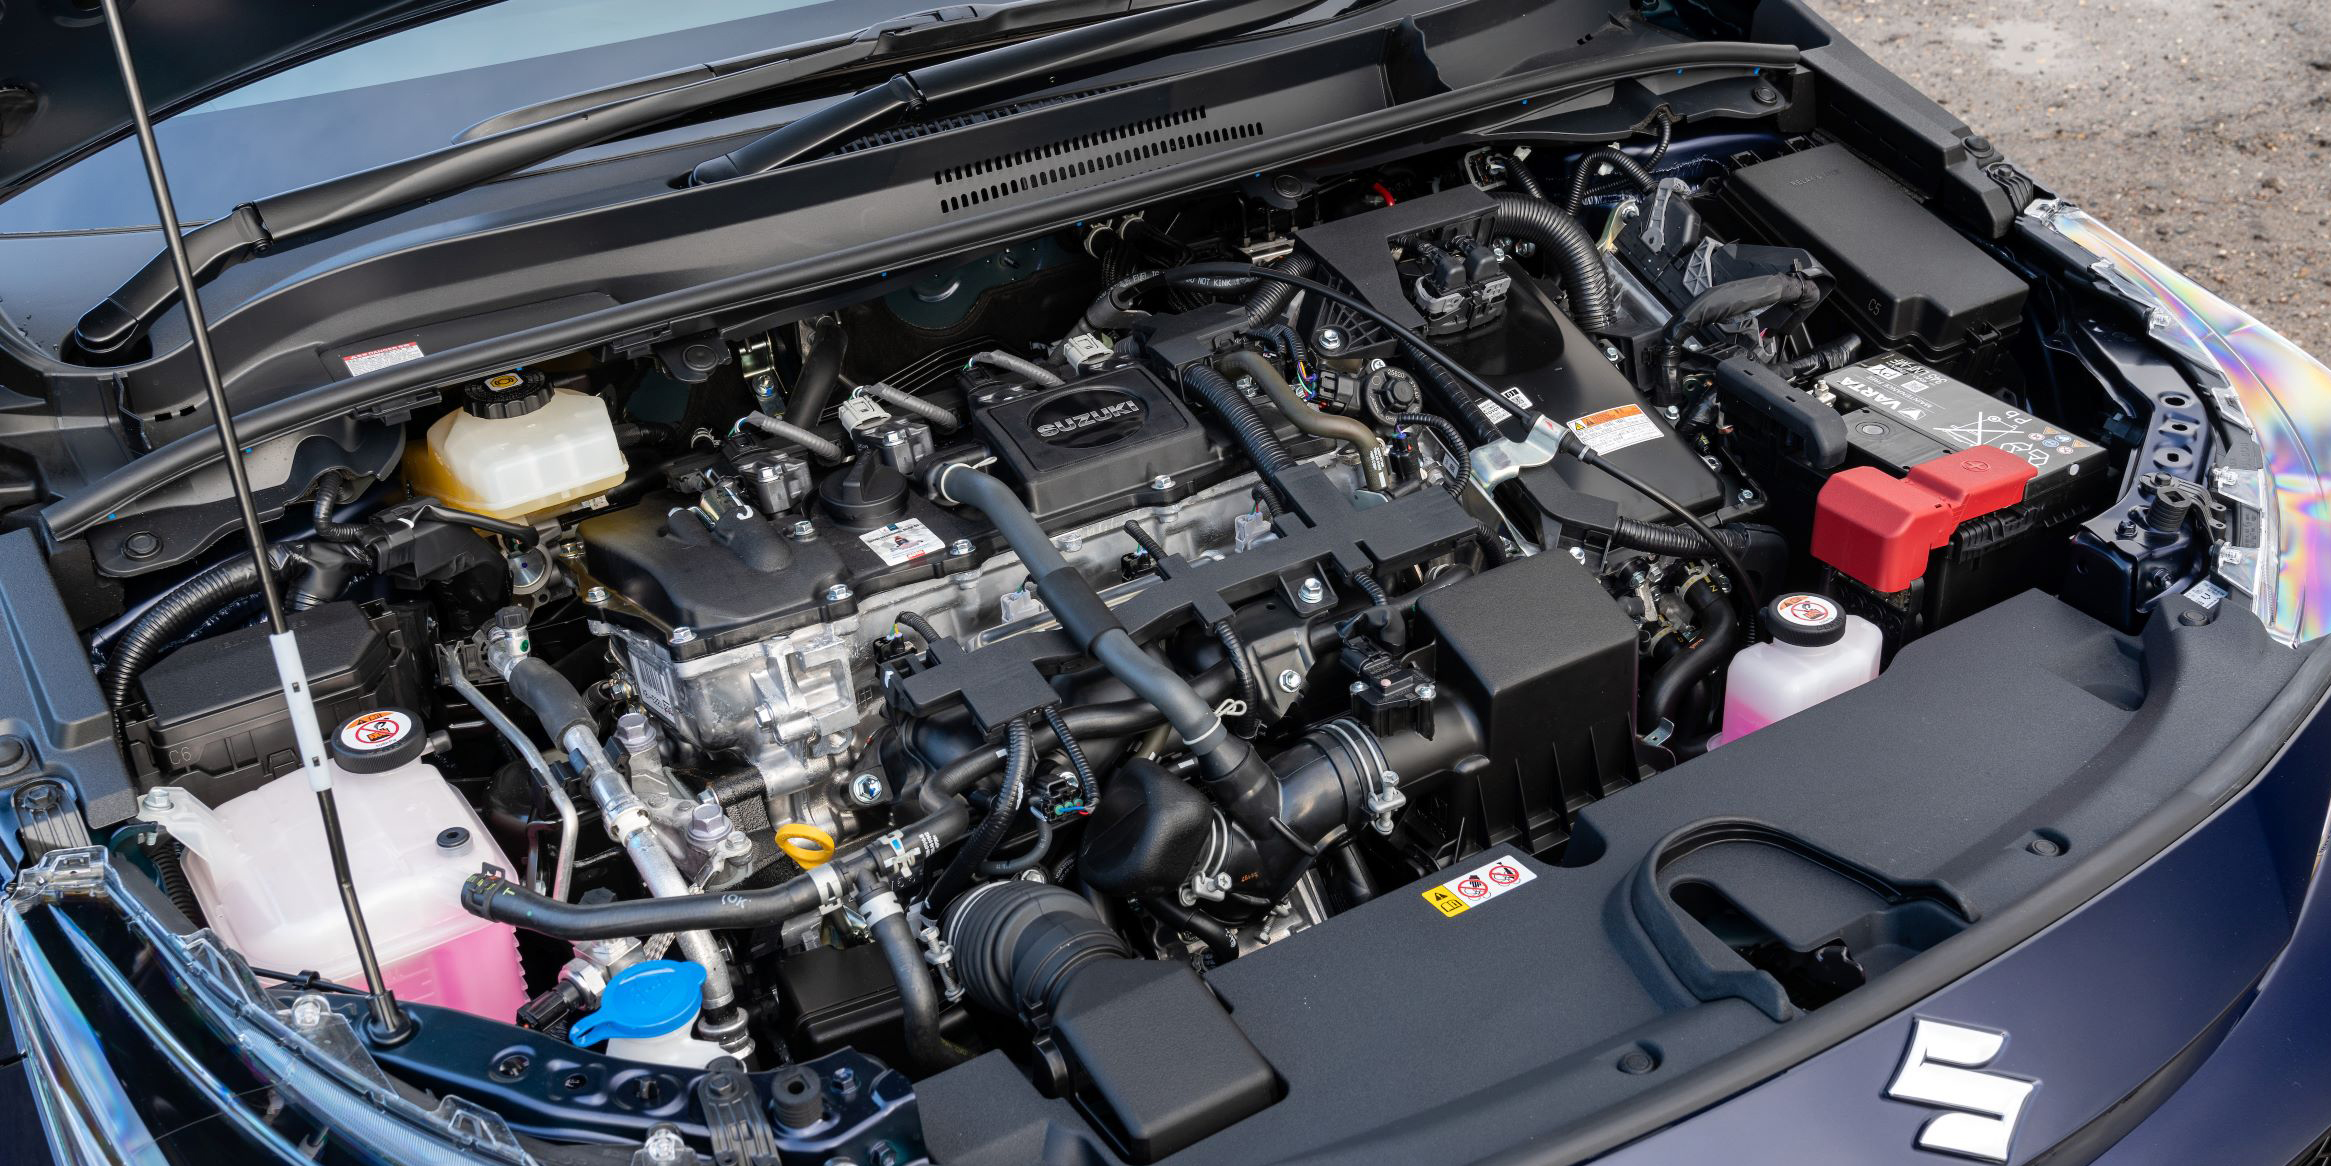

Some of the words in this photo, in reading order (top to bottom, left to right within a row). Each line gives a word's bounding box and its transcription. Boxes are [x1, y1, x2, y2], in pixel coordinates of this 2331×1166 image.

[1198, 277, 1210, 286] NOT
[1213, 279, 1232, 287] KINK
[1869, 298, 1881, 315] C5
[1841, 377, 1902, 410] VARTA
[1037, 400, 1140, 437] SUZUKI
[2005, 410, 2032, 425] Pb
[168, 746, 192, 765] C6
